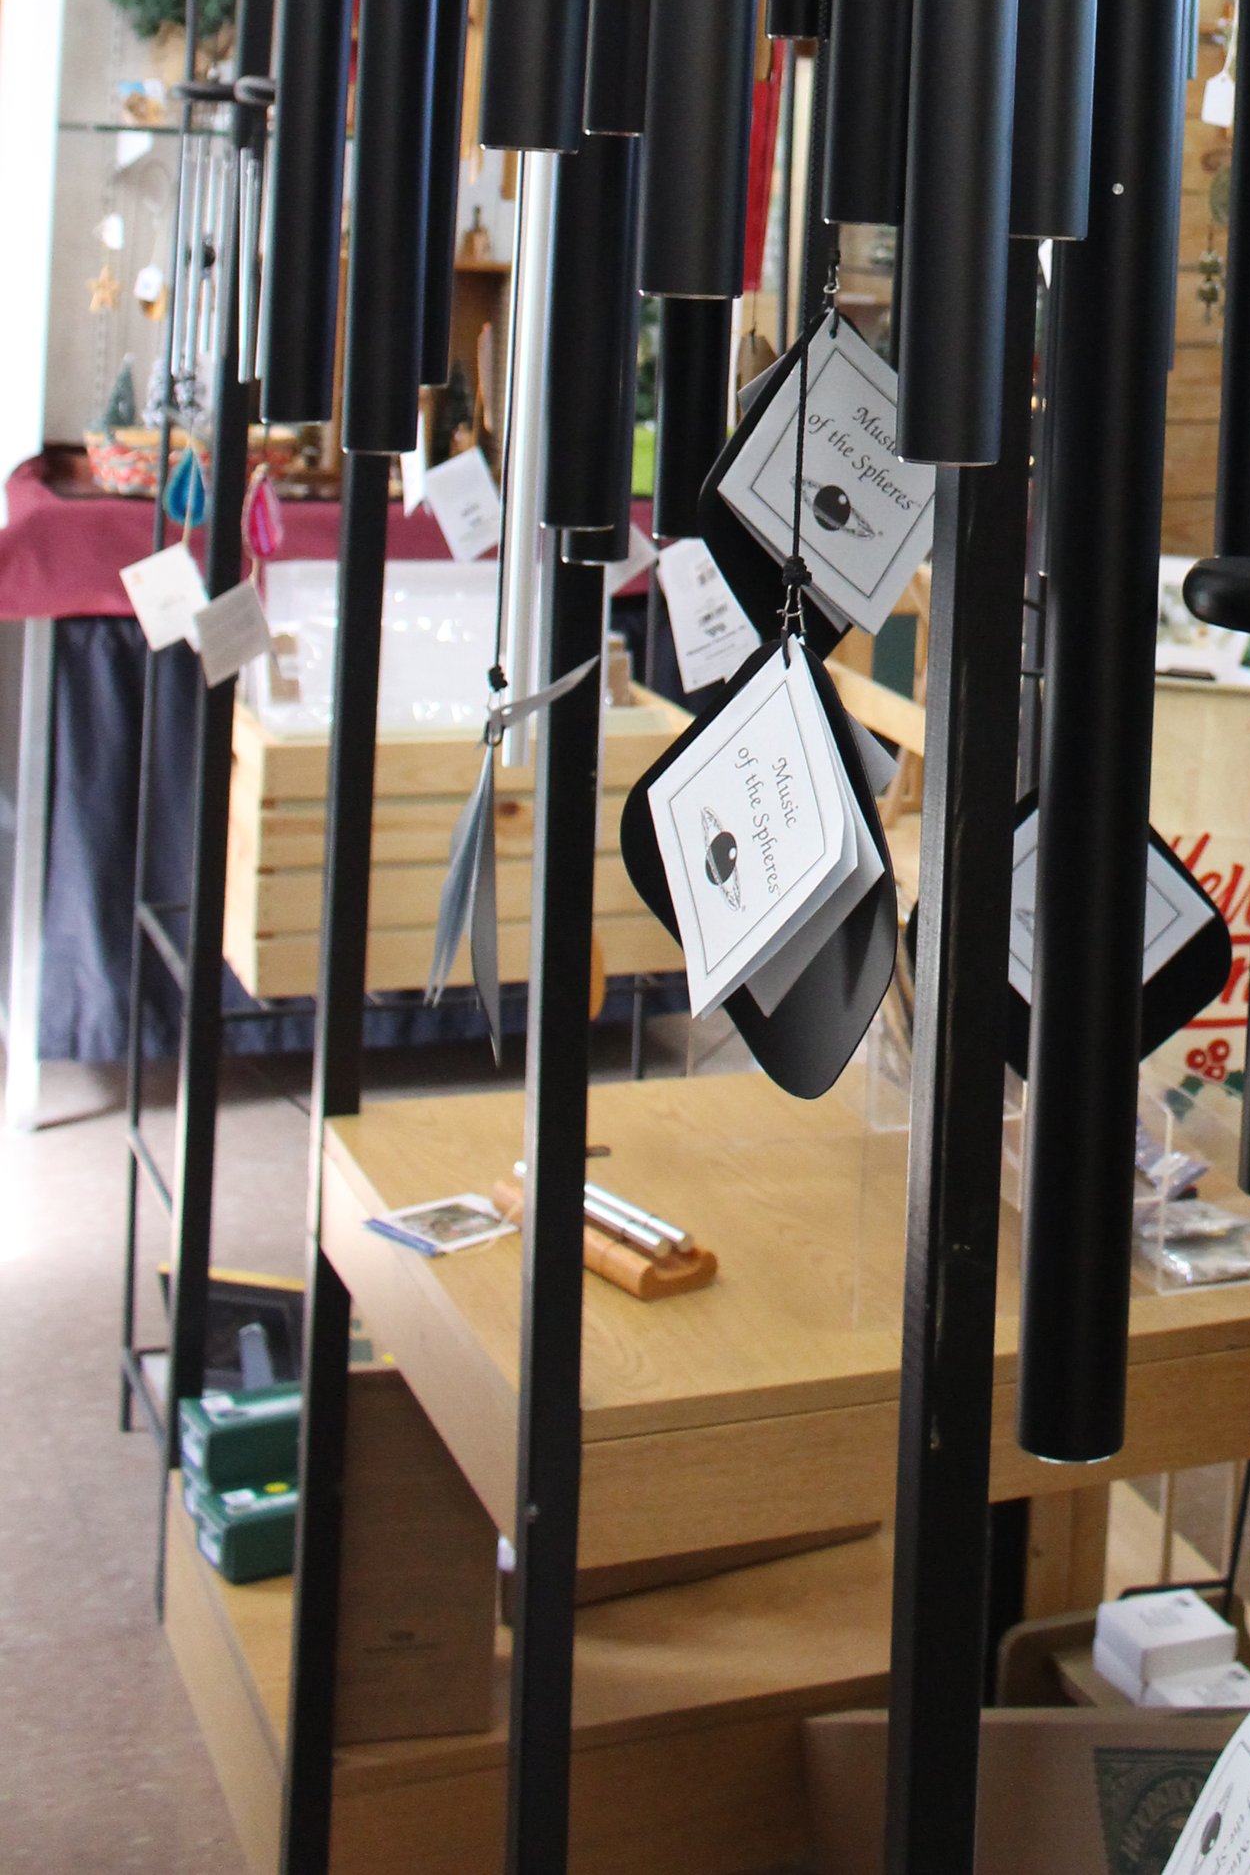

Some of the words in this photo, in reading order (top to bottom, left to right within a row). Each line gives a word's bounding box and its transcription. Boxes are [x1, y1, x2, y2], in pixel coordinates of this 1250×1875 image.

[808, 414, 835, 434] of
[828, 430, 851, 458] the
[851, 455, 914, 511] Spheres
[735, 747, 759, 769] of
[745, 773, 764, 810] the
[772, 757, 798, 829] Music
[752, 812, 779, 894] Spheres
